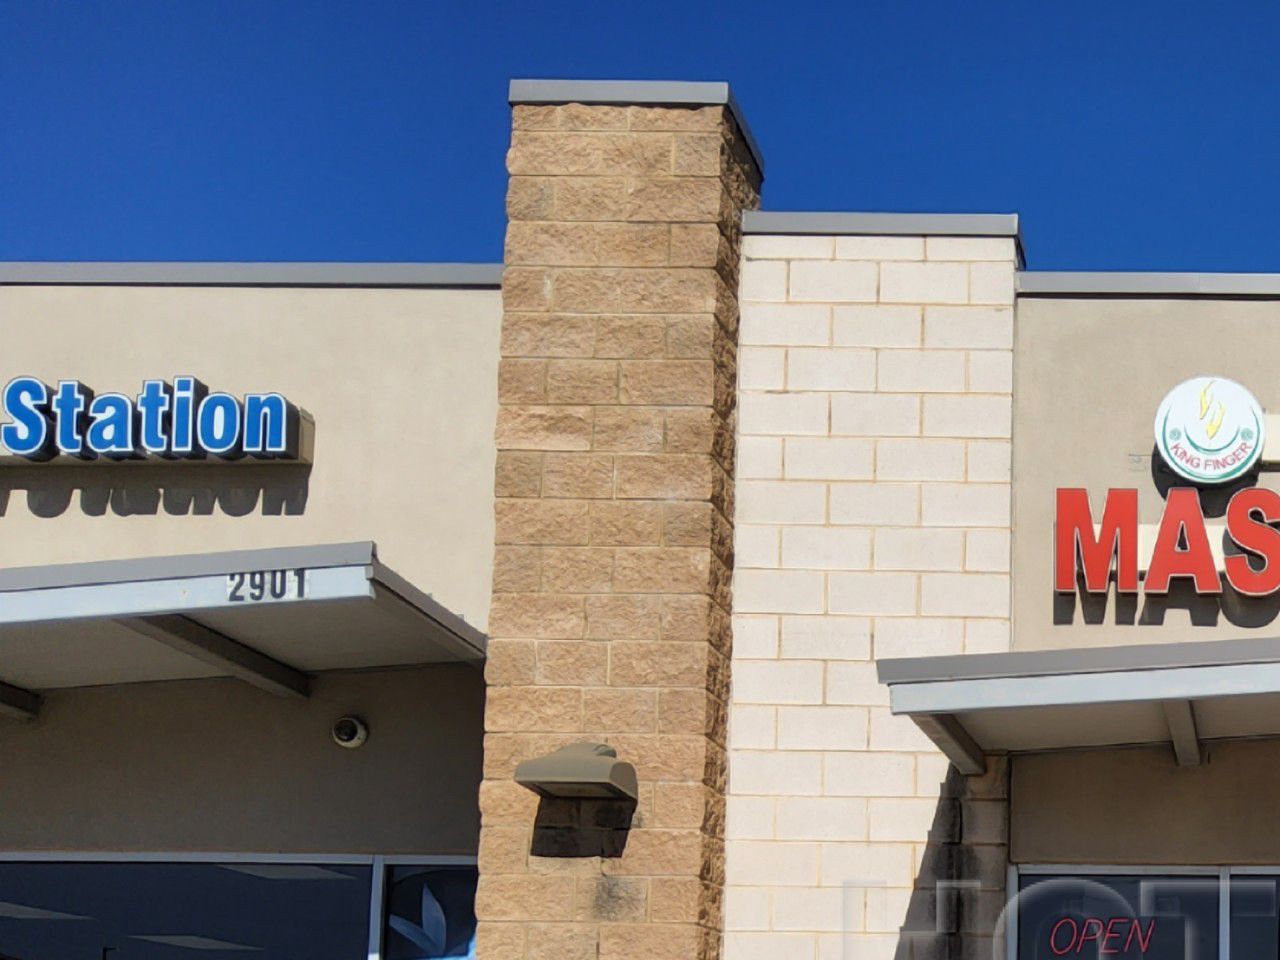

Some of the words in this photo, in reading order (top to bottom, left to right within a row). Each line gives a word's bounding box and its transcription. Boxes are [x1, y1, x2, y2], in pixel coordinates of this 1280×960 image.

[2, 375, 288, 454] Station
[1170, 442, 1200, 469] KING
[1204, 441, 1253, 471] FINGER
[228, 567, 306, 602] 2901
[1050, 918, 1155, 954] OPEN
